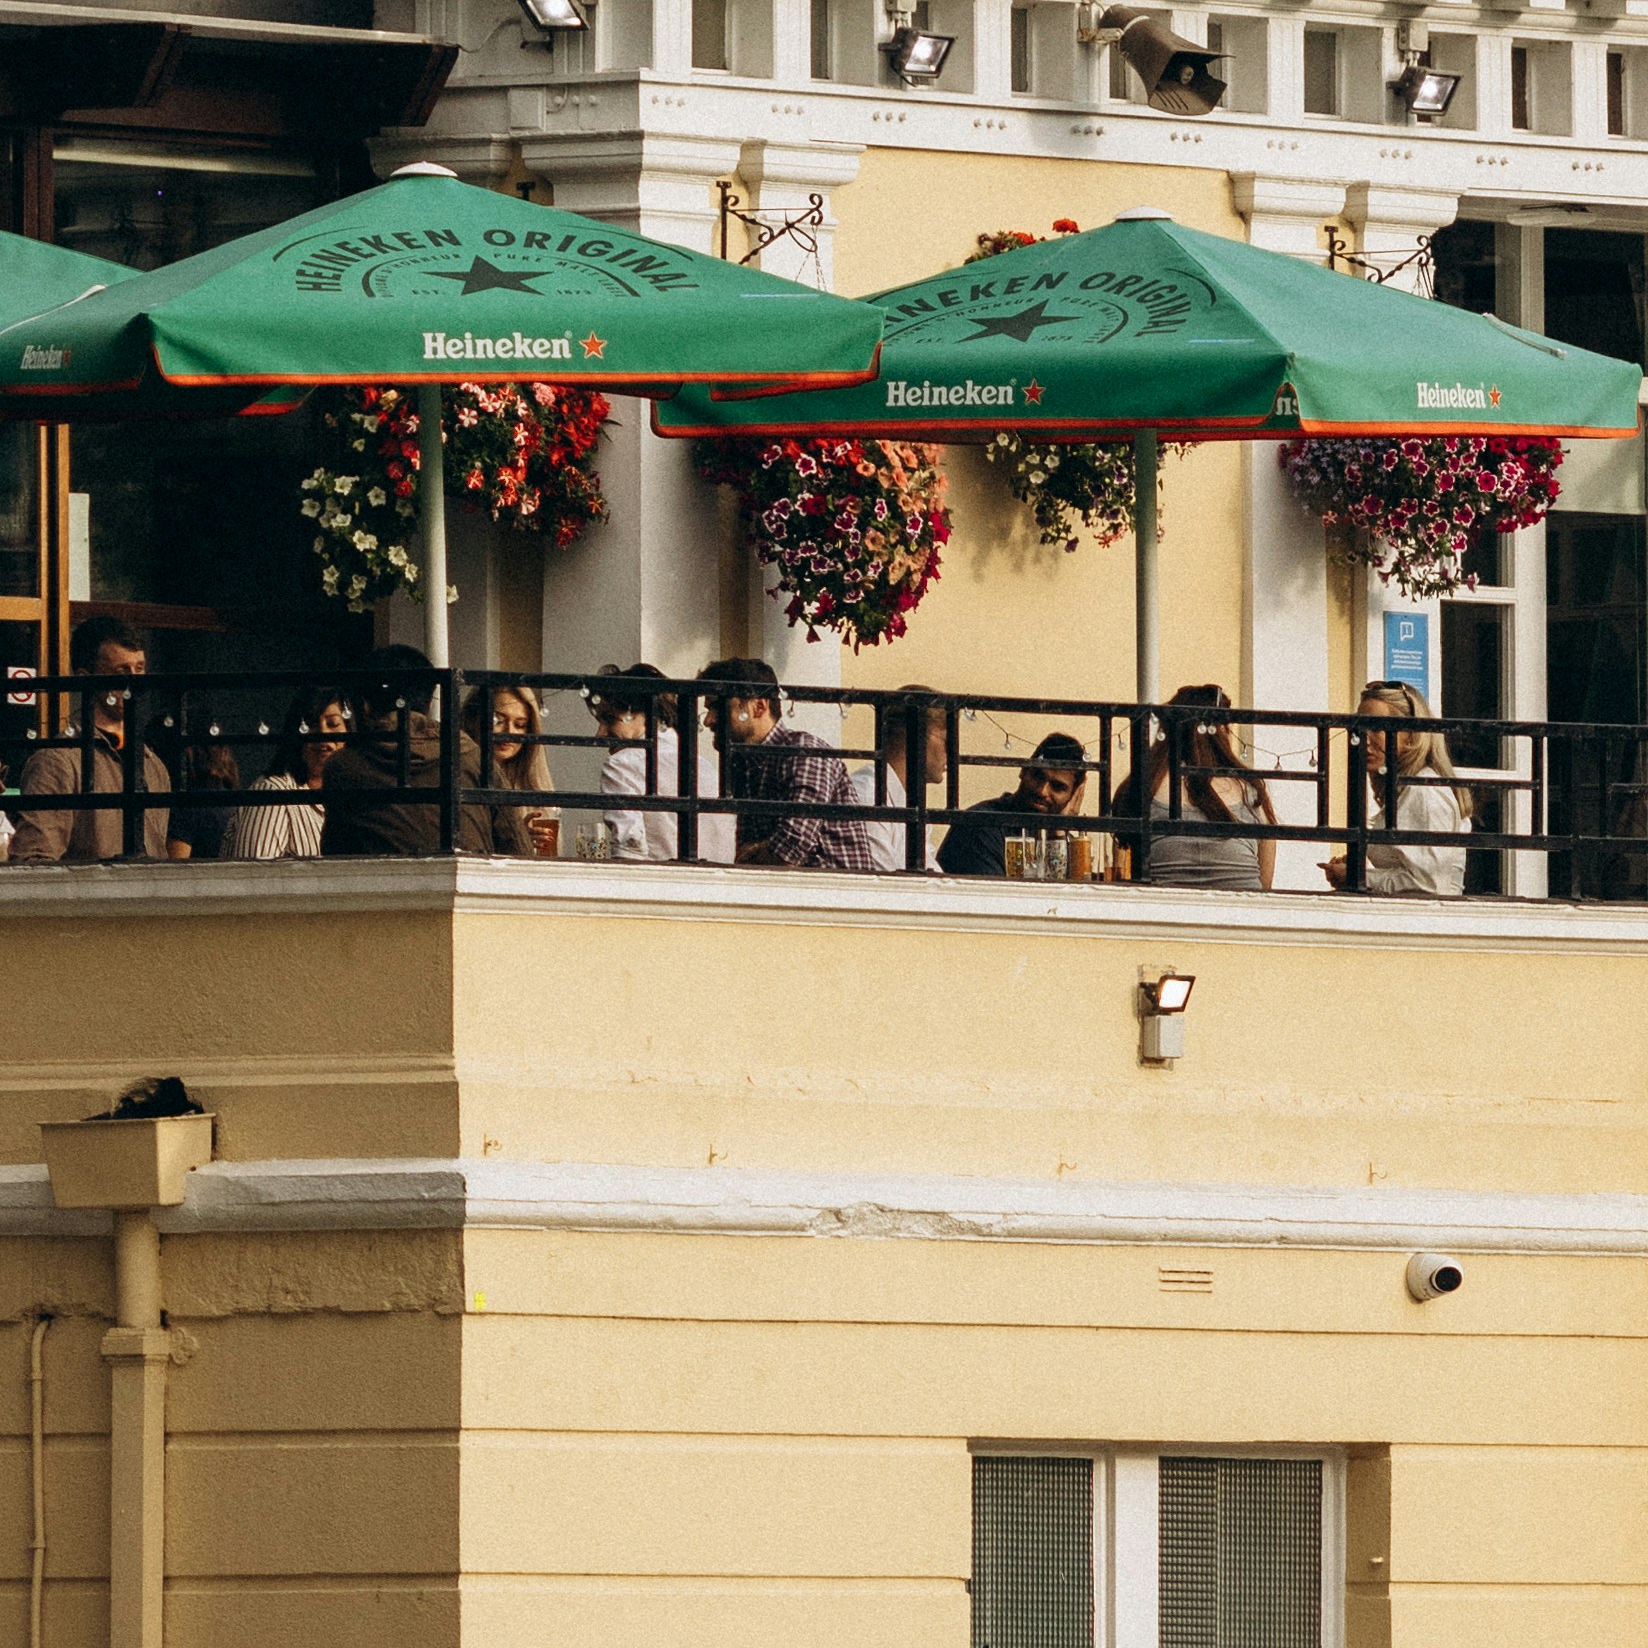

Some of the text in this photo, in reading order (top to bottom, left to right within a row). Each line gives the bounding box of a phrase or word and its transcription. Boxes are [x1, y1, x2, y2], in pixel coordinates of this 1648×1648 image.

[296, 229, 700, 293] HEINEKEN ORIGINAL
[883, 271, 1192, 337] INEKEN ORIGINAL
[423, 332, 572, 359] Heineken
[886, 380, 1015, 406] Heineken
[1416, 382, 1486, 409] Heineken
